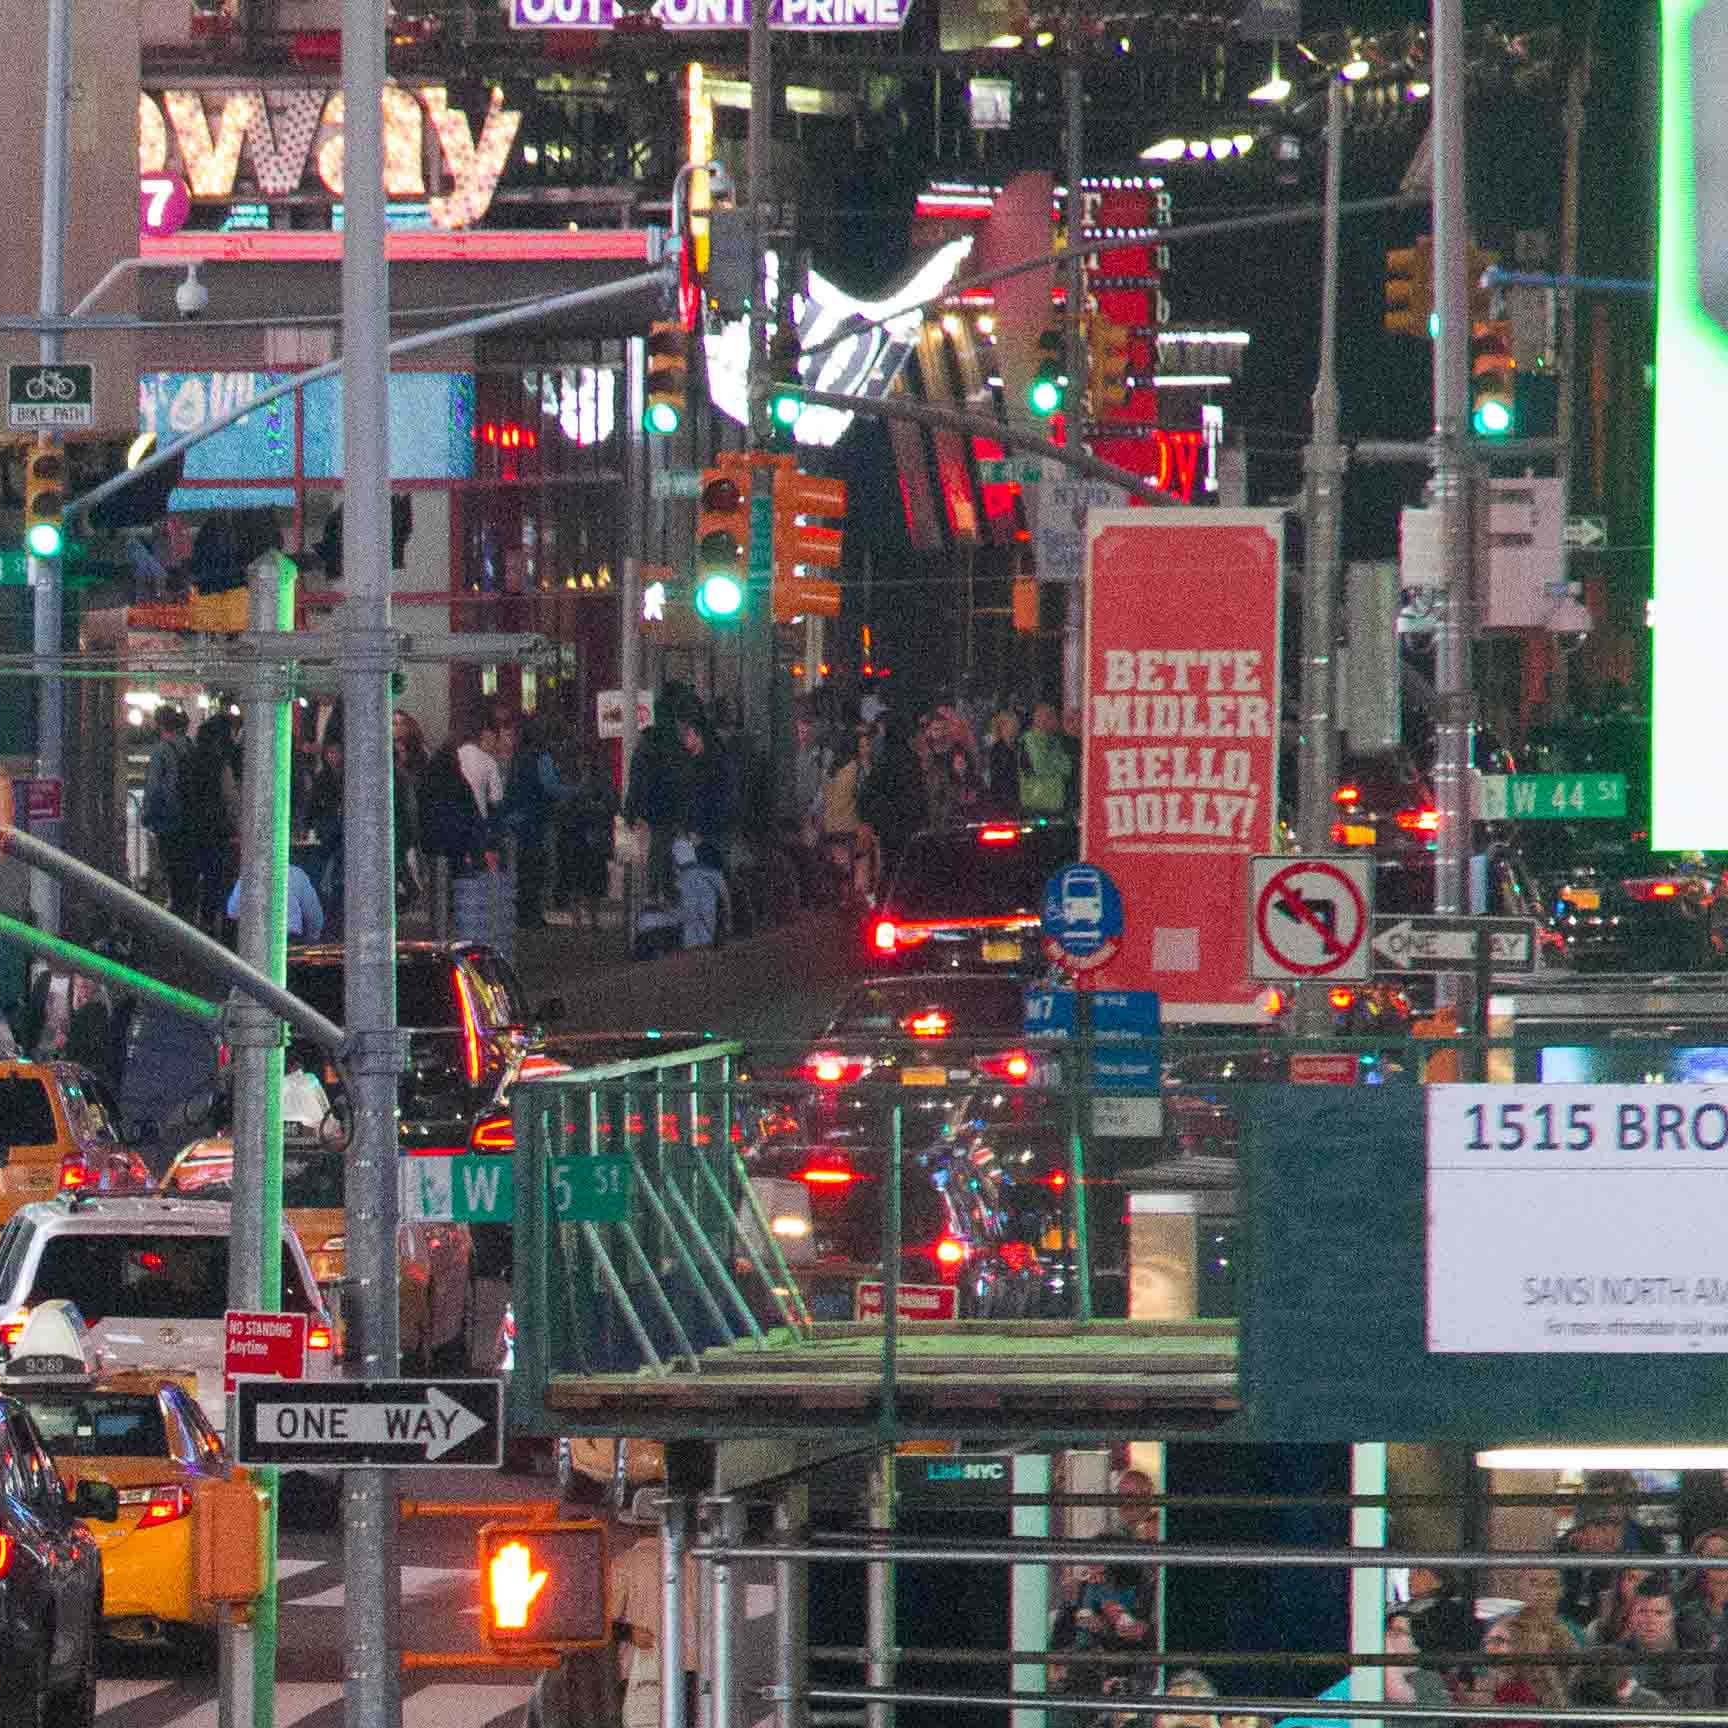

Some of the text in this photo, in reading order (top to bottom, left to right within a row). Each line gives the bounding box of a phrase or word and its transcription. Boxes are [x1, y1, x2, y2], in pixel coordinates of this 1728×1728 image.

[141, 180, 174, 226] 7
[16, 406, 86, 423] BIKE PATH
[1104, 651, 1262, 692] BETTE
[1093, 697, 1271, 739] MIDLER
[1106, 747, 1258, 793] HELLO,
[1105, 794, 1253, 840] DOLLY!
[1512, 783, 1537, 813] W
[1550, 781, 1585, 811] 44
[1388, 933, 1432, 961] ONE
[1463, 1102, 1597, 1152] 1515
[463, 1167, 501, 1214] W
[228, 1320, 293, 1339] NO STANDING
[229, 1339, 269, 1357] Anytime
[275, 1405, 461, 1440] ONE WAY
